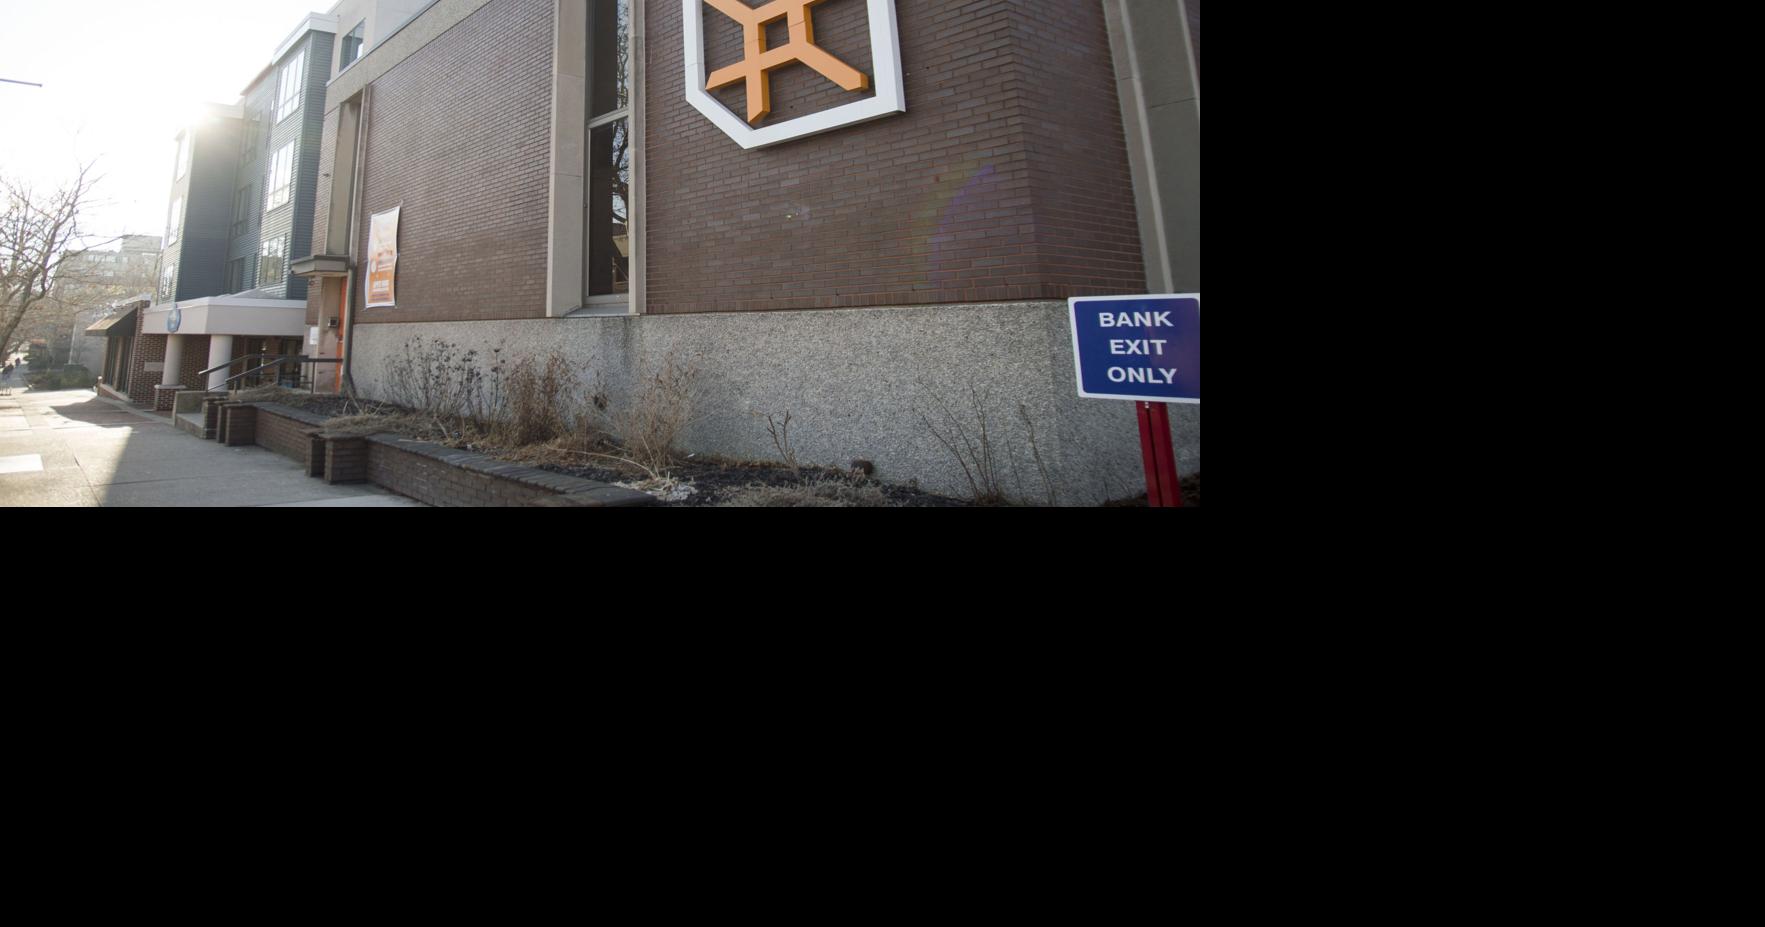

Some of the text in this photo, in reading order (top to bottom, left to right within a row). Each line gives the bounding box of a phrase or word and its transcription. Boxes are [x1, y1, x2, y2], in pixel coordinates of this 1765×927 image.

[1098, 311, 1174, 327] BANK
[1109, 339, 1167, 355] EXIT
[1107, 366, 1177, 384] ONLY
